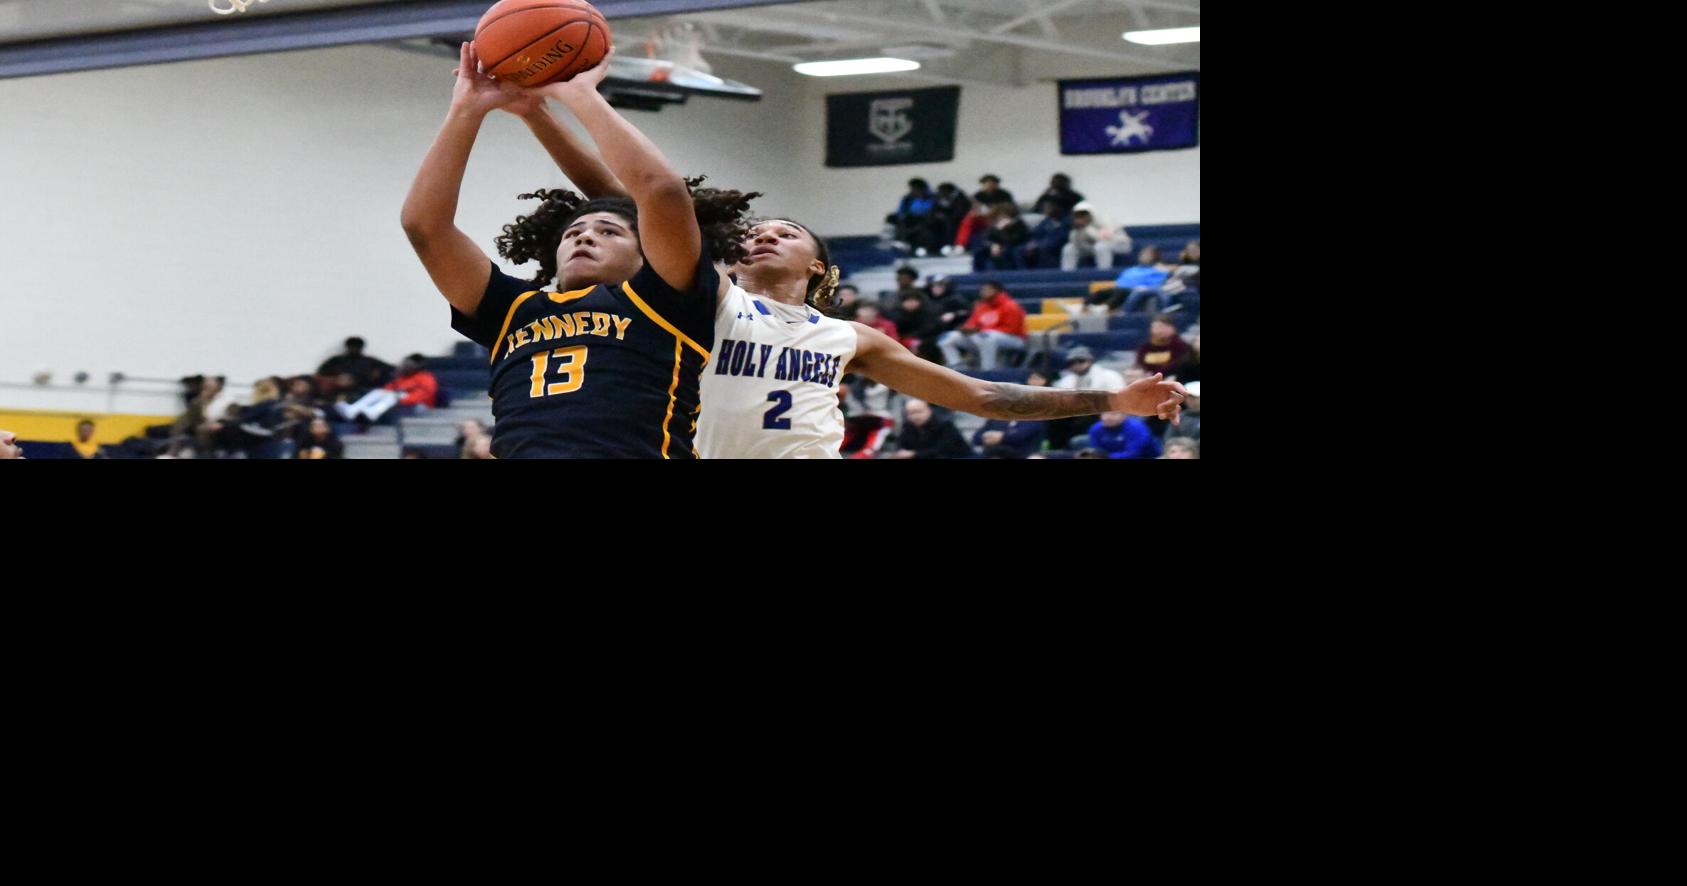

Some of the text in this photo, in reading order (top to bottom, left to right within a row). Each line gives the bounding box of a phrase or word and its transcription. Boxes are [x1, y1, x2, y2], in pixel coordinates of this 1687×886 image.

[502, 39, 575, 81] PALDING
[530, 345, 588, 398] 13
[715, 339, 773, 378] HOLY
[762, 389, 792, 430] 2
